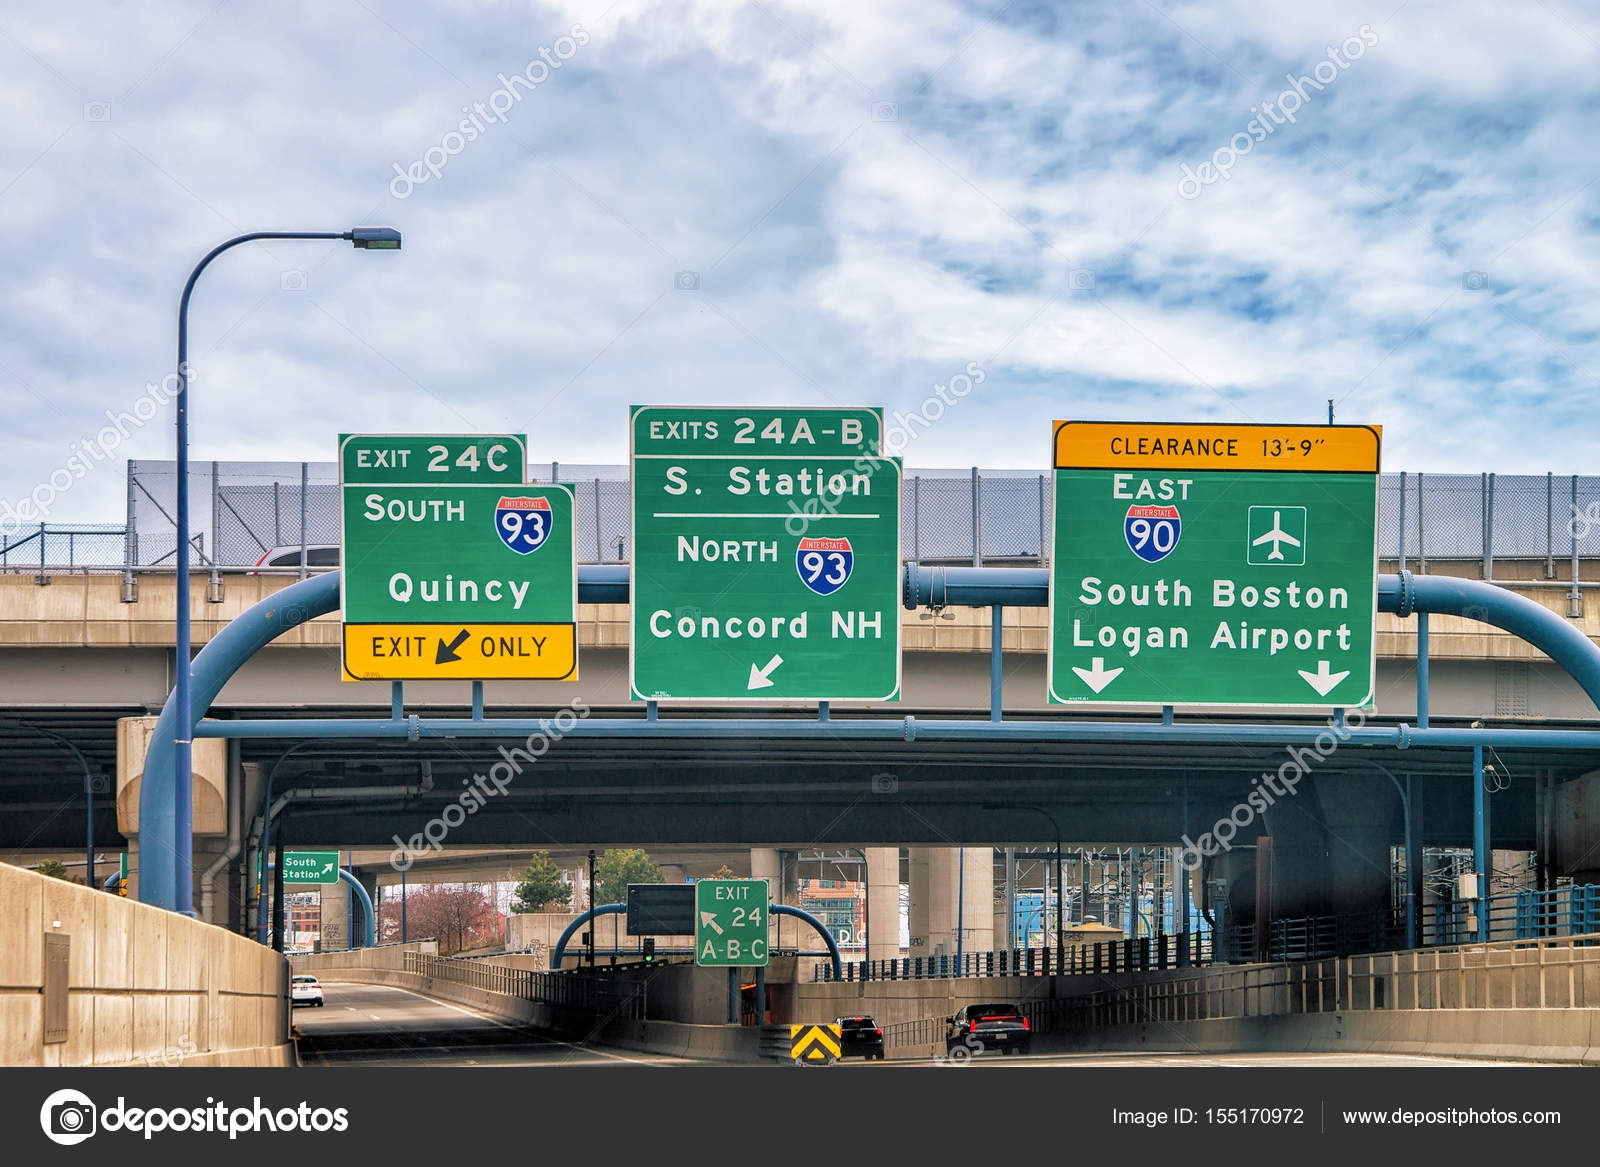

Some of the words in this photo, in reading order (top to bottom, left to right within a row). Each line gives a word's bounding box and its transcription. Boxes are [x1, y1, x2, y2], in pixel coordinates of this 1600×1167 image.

[651, 422, 719, 440] EXITS
[734, 418, 864, 445] 24A-B
[357, 449, 411, 468] EXIT
[427, 445, 508, 472] 24C
[1110, 437, 1238, 457] CLEARANCE
[664, 466, 702, 495] S.
[727, 466, 871, 496] Station
[1113, 474, 1193, 501] EAST
[363, 494, 465, 522] SOUTH
[505, 501, 542, 509] INTERSTATE
[1134, 509, 1172, 517] INTERSTATE
[502, 512, 544, 545] 93
[1130, 519, 1175, 553] 90
[677, 536, 778, 562] NORTH
[806, 541, 844, 549] INTERSTATE
[803, 552, 847, 585] 93
[388, 573, 530, 610] Quincy
[1078, 577, 1192, 607] South
[1213, 579, 1348, 609] Boston
[650, 610, 808, 639] Concord
[831, 611, 882, 639] NH
[372, 636, 426, 657] EXIT
[481, 637, 547, 658] ONLY
[1073, 620, 1189, 657] Logan
[1210, 621, 1351, 656] Airport
[283, 869, 320, 879] Station
[285, 857, 317, 867] South
[715, 886, 750, 900] EXIT
[732, 907, 762, 927] 24
[701, 939, 765, 959] A-B-C
